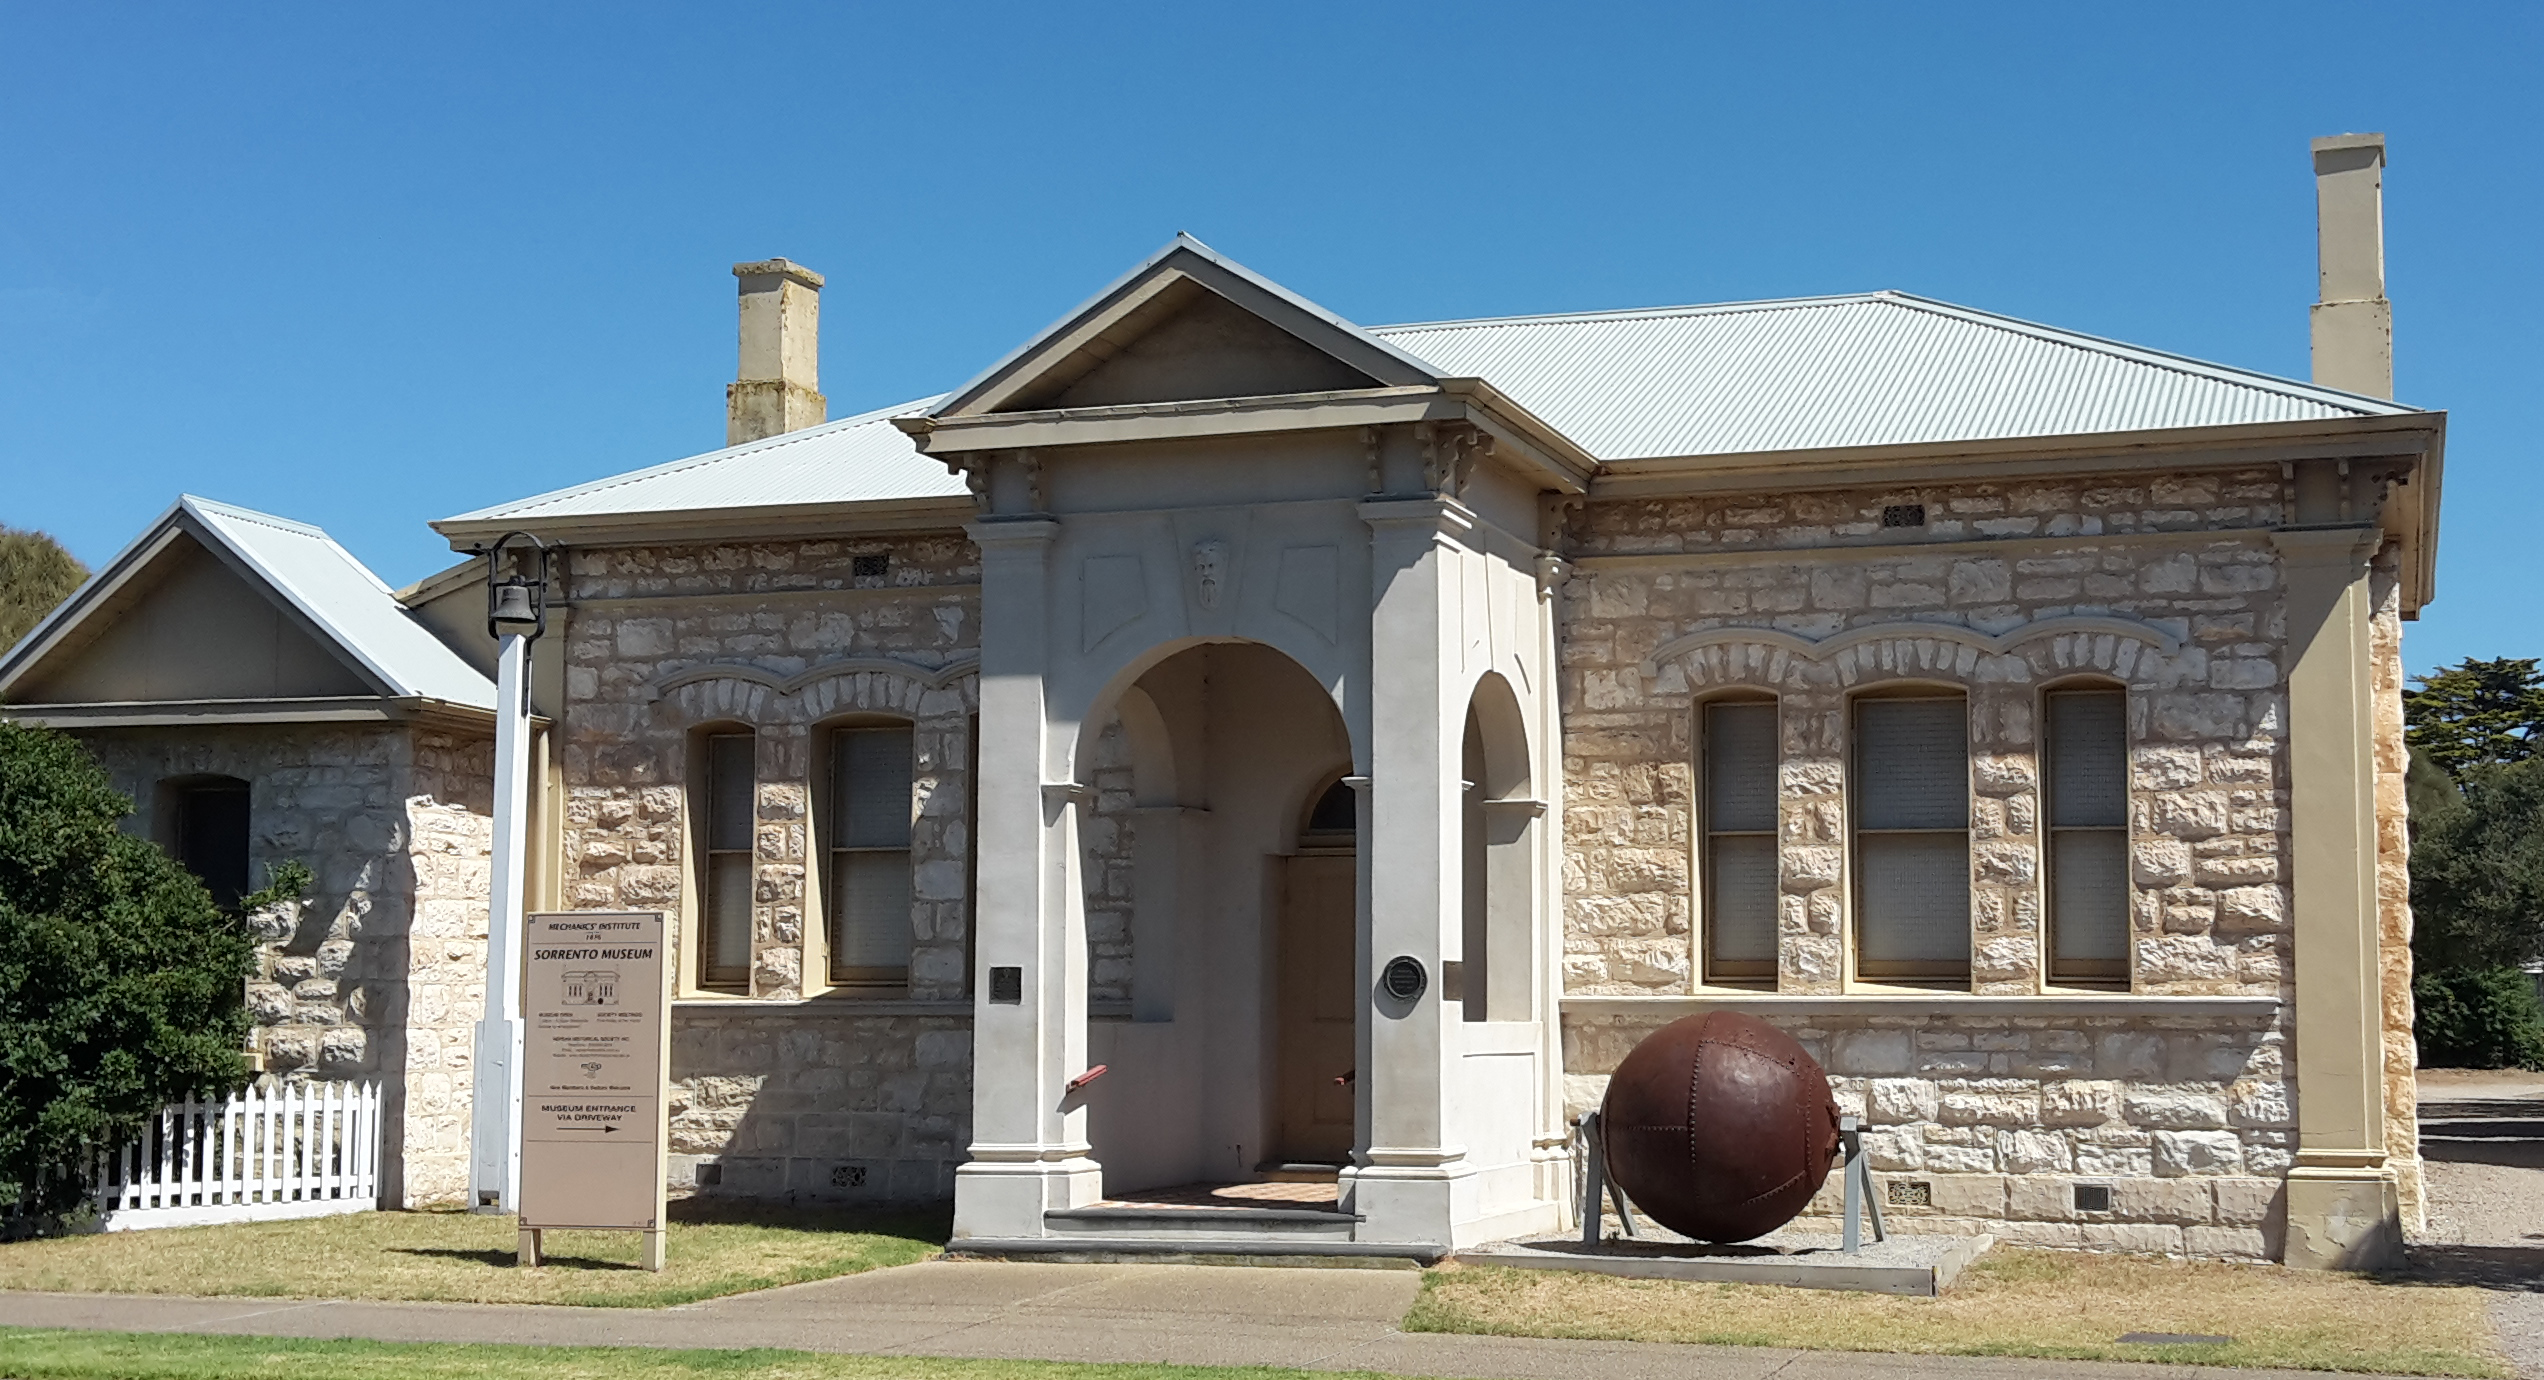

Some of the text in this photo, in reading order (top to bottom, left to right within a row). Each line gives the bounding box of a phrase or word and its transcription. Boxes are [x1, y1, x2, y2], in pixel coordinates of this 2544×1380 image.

[598, 922, 641, 930] INSTITUTE
[533, 948, 653, 961] SORRENTO MUSEUM
[541, 1104, 637, 1113] MUSEUM ENTRANCE
[557, 1113, 623, 1121] VIA DRIVEWAY
